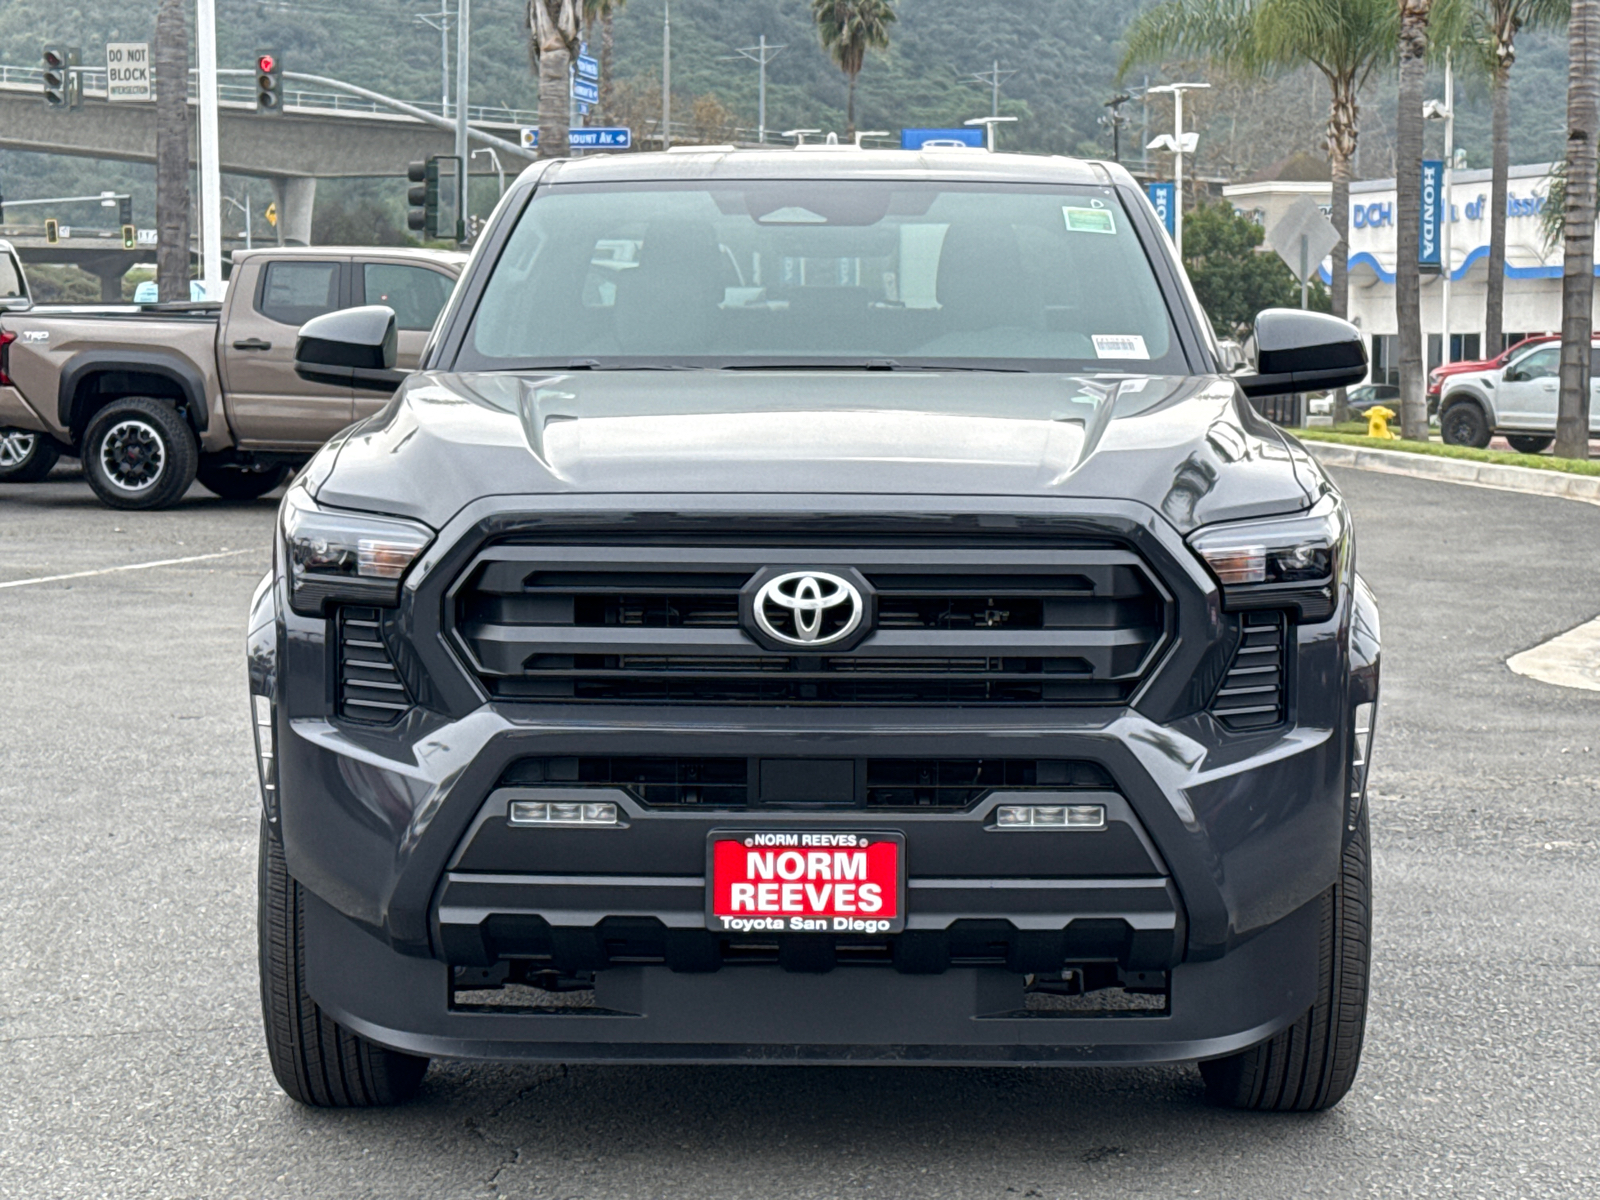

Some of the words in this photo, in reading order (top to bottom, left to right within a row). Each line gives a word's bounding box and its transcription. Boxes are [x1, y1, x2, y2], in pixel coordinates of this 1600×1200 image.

[109, 49, 123, 62] DO
[127, 49, 146, 62] NOT
[110, 67, 148, 81] BLOCK
[1353, 202, 1393, 229] DCH
[1422, 167, 1436, 259] HONDA
[1465, 193, 1487, 221] of
[754, 834, 799, 847] NORM
[802, 834, 857, 847] REEVES
[746, 851, 868, 881] NORM
[730, 882, 883, 913] REEVES
[719, 915, 785, 932] Toyota
[789, 916, 827, 931] San
[833, 917, 891, 934] Diego
